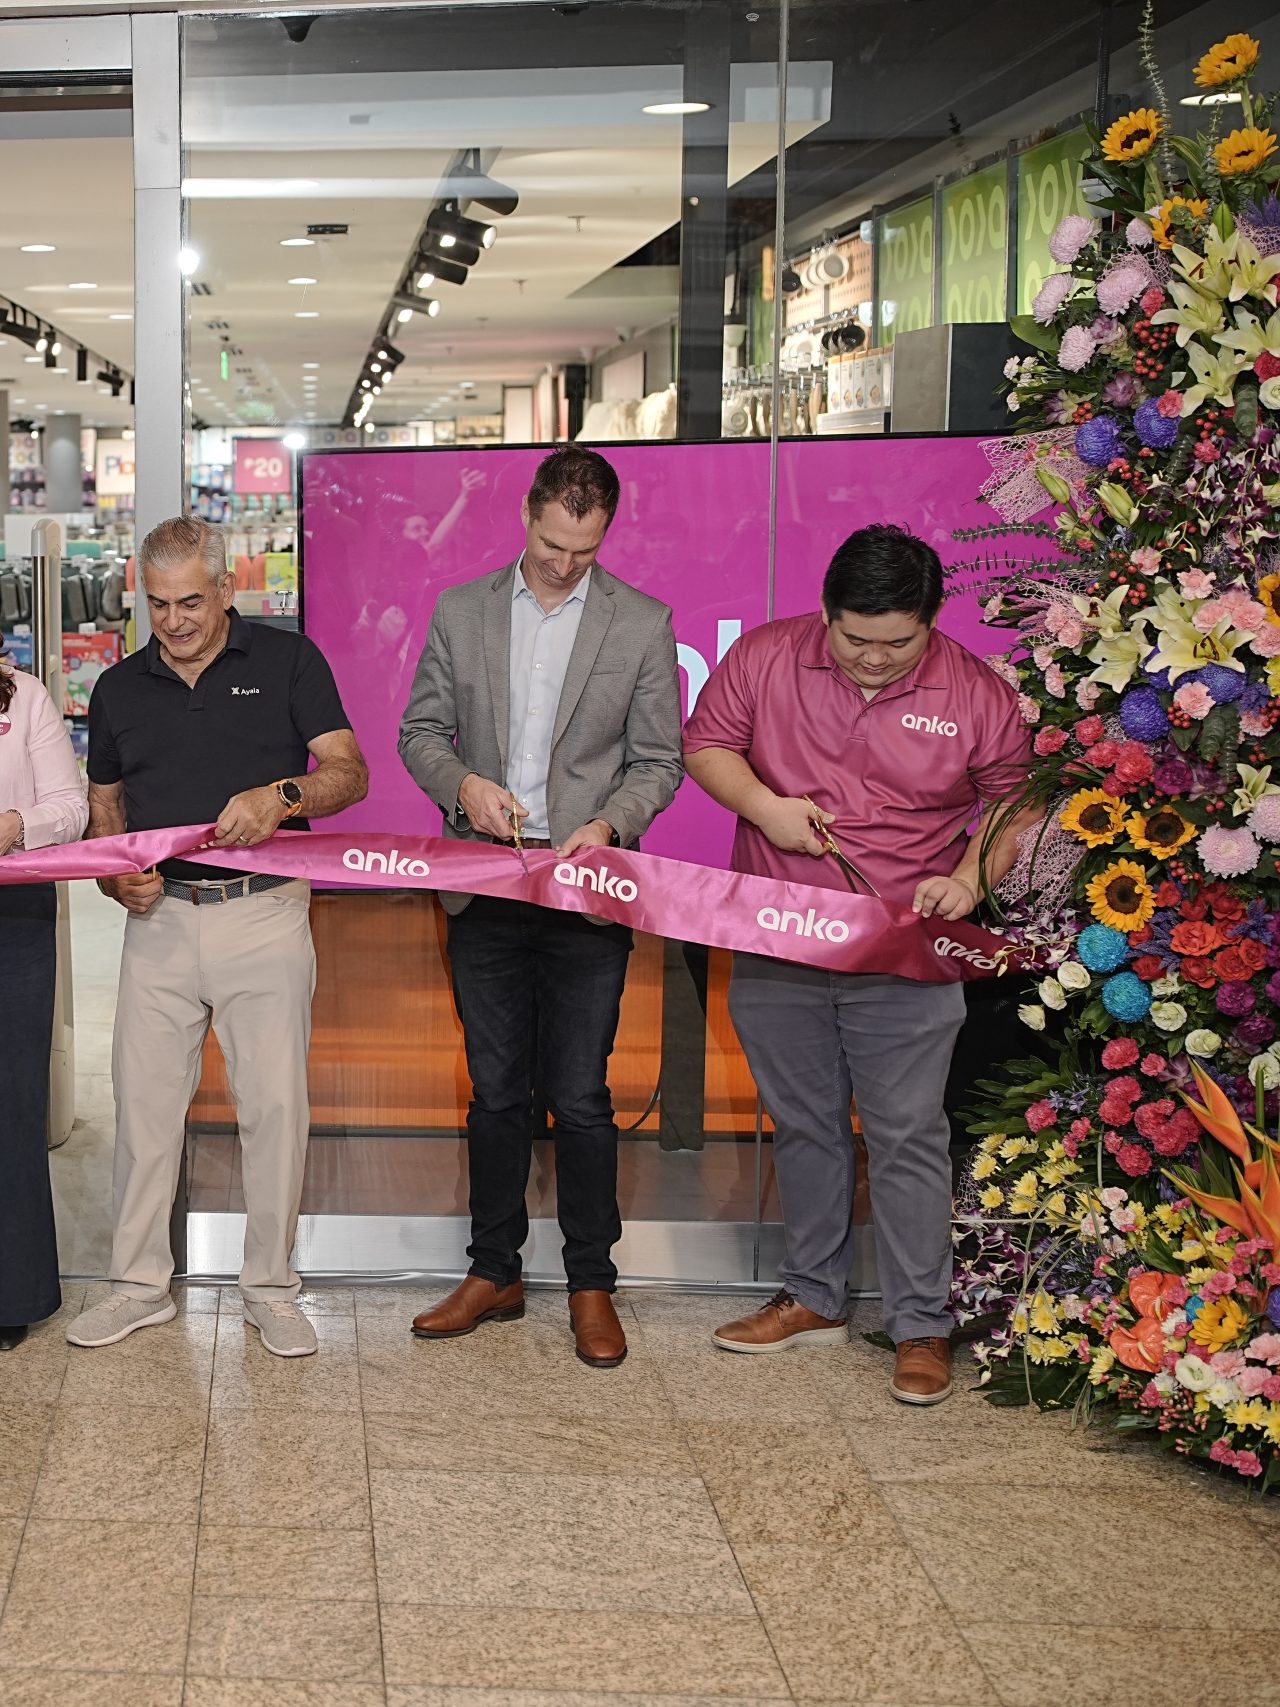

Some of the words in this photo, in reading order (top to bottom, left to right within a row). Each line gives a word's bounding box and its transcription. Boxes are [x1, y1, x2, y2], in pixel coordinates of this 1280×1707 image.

[240, 687, 260, 696] Ayala
[901, 713, 958, 738] anko
[342, 848, 430, 877] anko
[553, 863, 638, 902] anko
[756, 907, 850, 943] anko
[933, 936, 998, 970] anko
